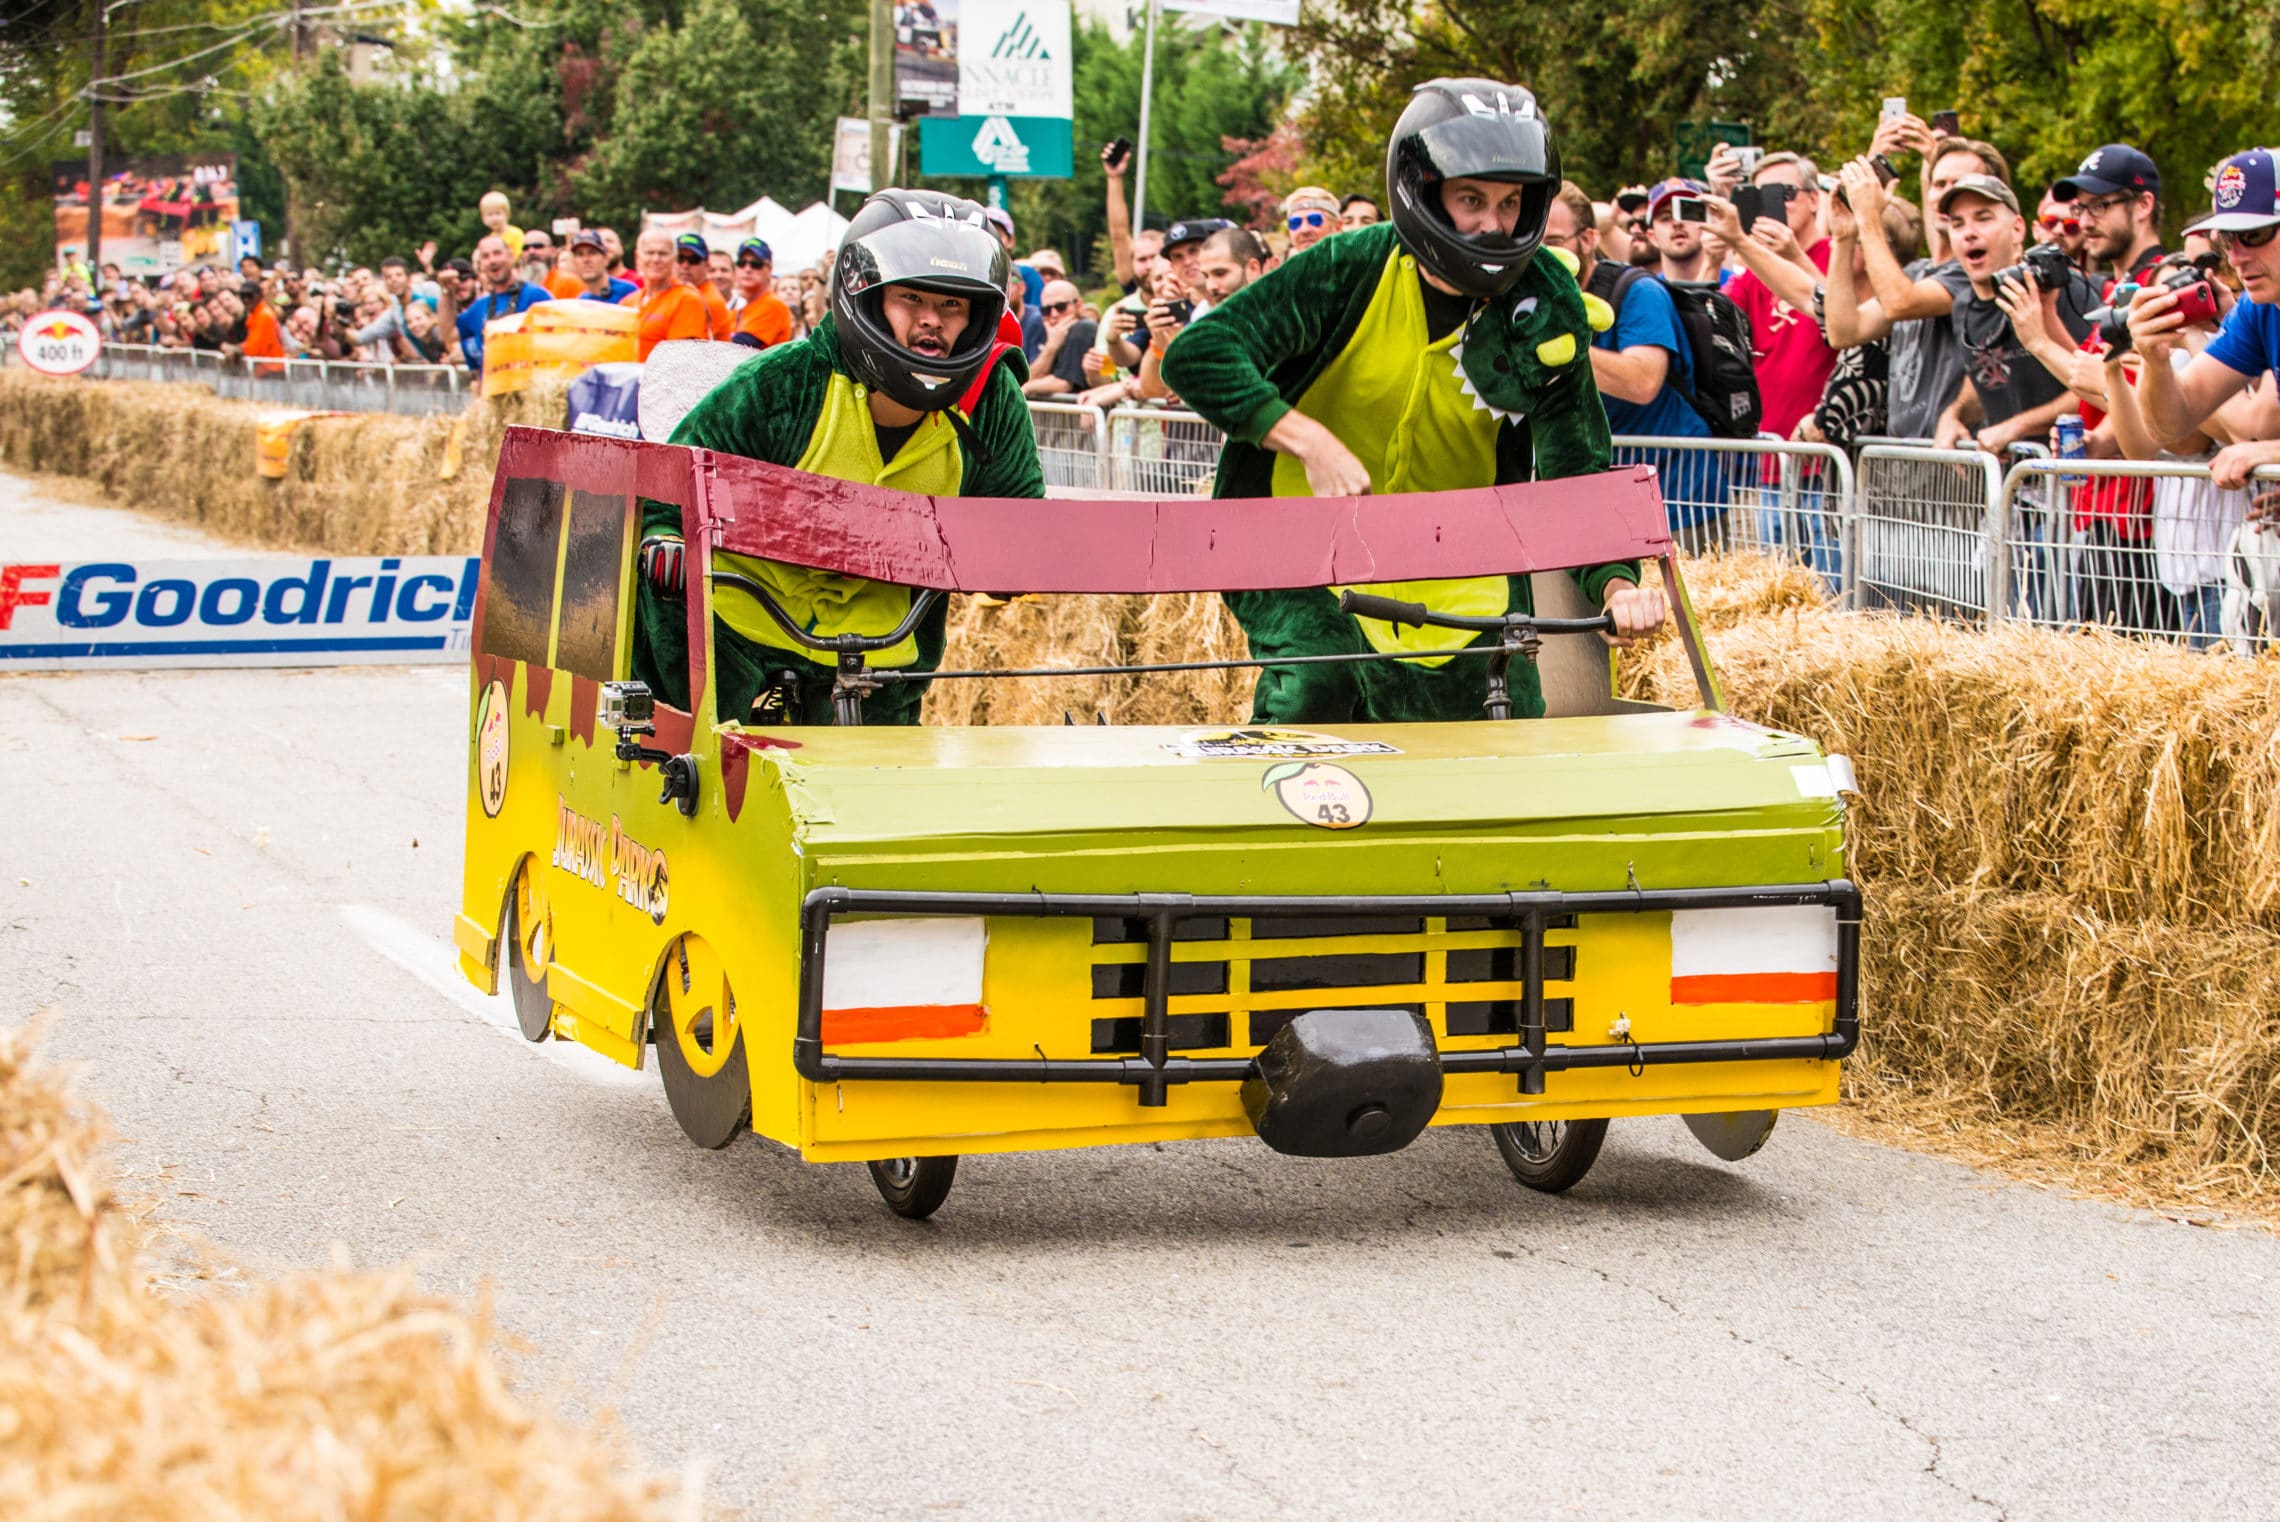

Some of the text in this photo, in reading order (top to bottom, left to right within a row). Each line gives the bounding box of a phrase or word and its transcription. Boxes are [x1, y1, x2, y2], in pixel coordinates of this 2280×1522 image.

[38, 345, 67, 360] 400
[0, 557, 481, 631] FGoodric
[489, 761, 502, 805] 43
[1317, 803, 1351, 823] 43
[552, 791, 608, 891] JURASSIC
